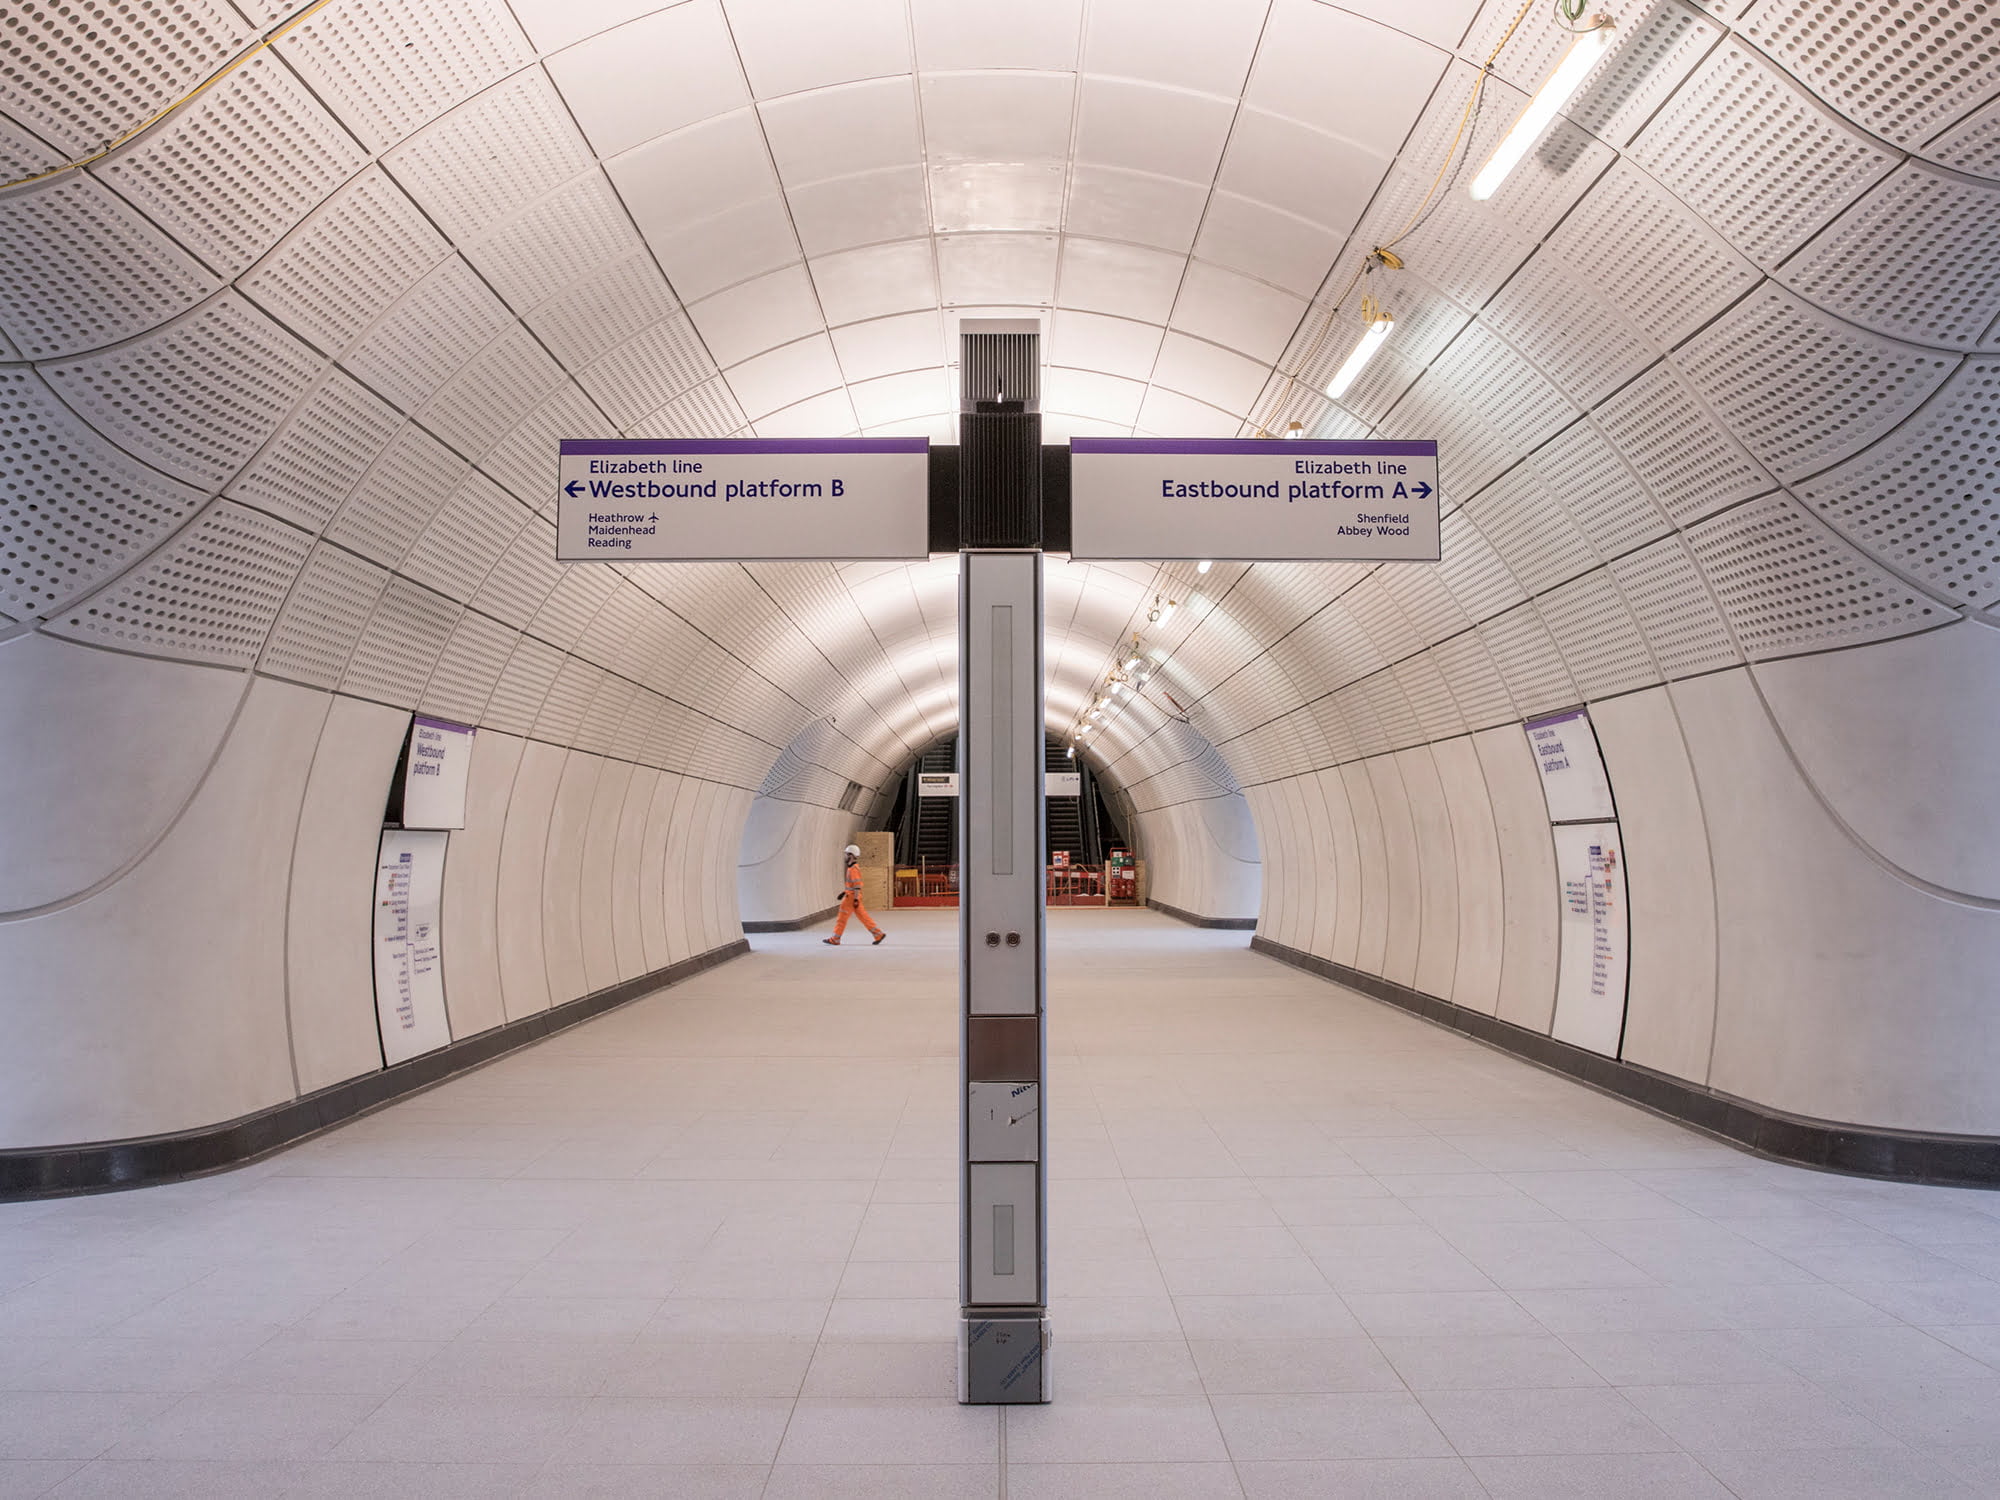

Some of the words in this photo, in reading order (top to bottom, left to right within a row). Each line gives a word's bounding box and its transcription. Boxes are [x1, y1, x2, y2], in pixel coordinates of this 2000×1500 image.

[590, 459, 667, 474] Elizabeth
[672, 459, 703, 474] line
[1295, 460, 1372, 475] Elizabeth
[1377, 460, 1407, 475] line
[589, 479, 717, 499] Westbound
[725, 478, 822, 502] platform
[831, 479, 845, 497] B
[1162, 479, 1280, 499] Eastbound
[1288, 480, 1384, 503] platform
[1391, 481, 1409, 499] A
[588, 512, 645, 523] Heathrow
[1357, 513, 1409, 524] Shenfield
[588, 525, 656, 536] Maidenhead
[1337, 525, 1373, 538] Abbey
[1376, 525, 1410, 536] Wood
[588, 537, 632, 550] Reading
[416, 742, 446, 760] Westbound
[1537, 740, 1565, 756] Eastbound
[413, 761, 436, 776] platform
[436, 763, 441, 776] B
[1543, 758, 1565, 775] platform
[1565, 756, 1571, 769] A
